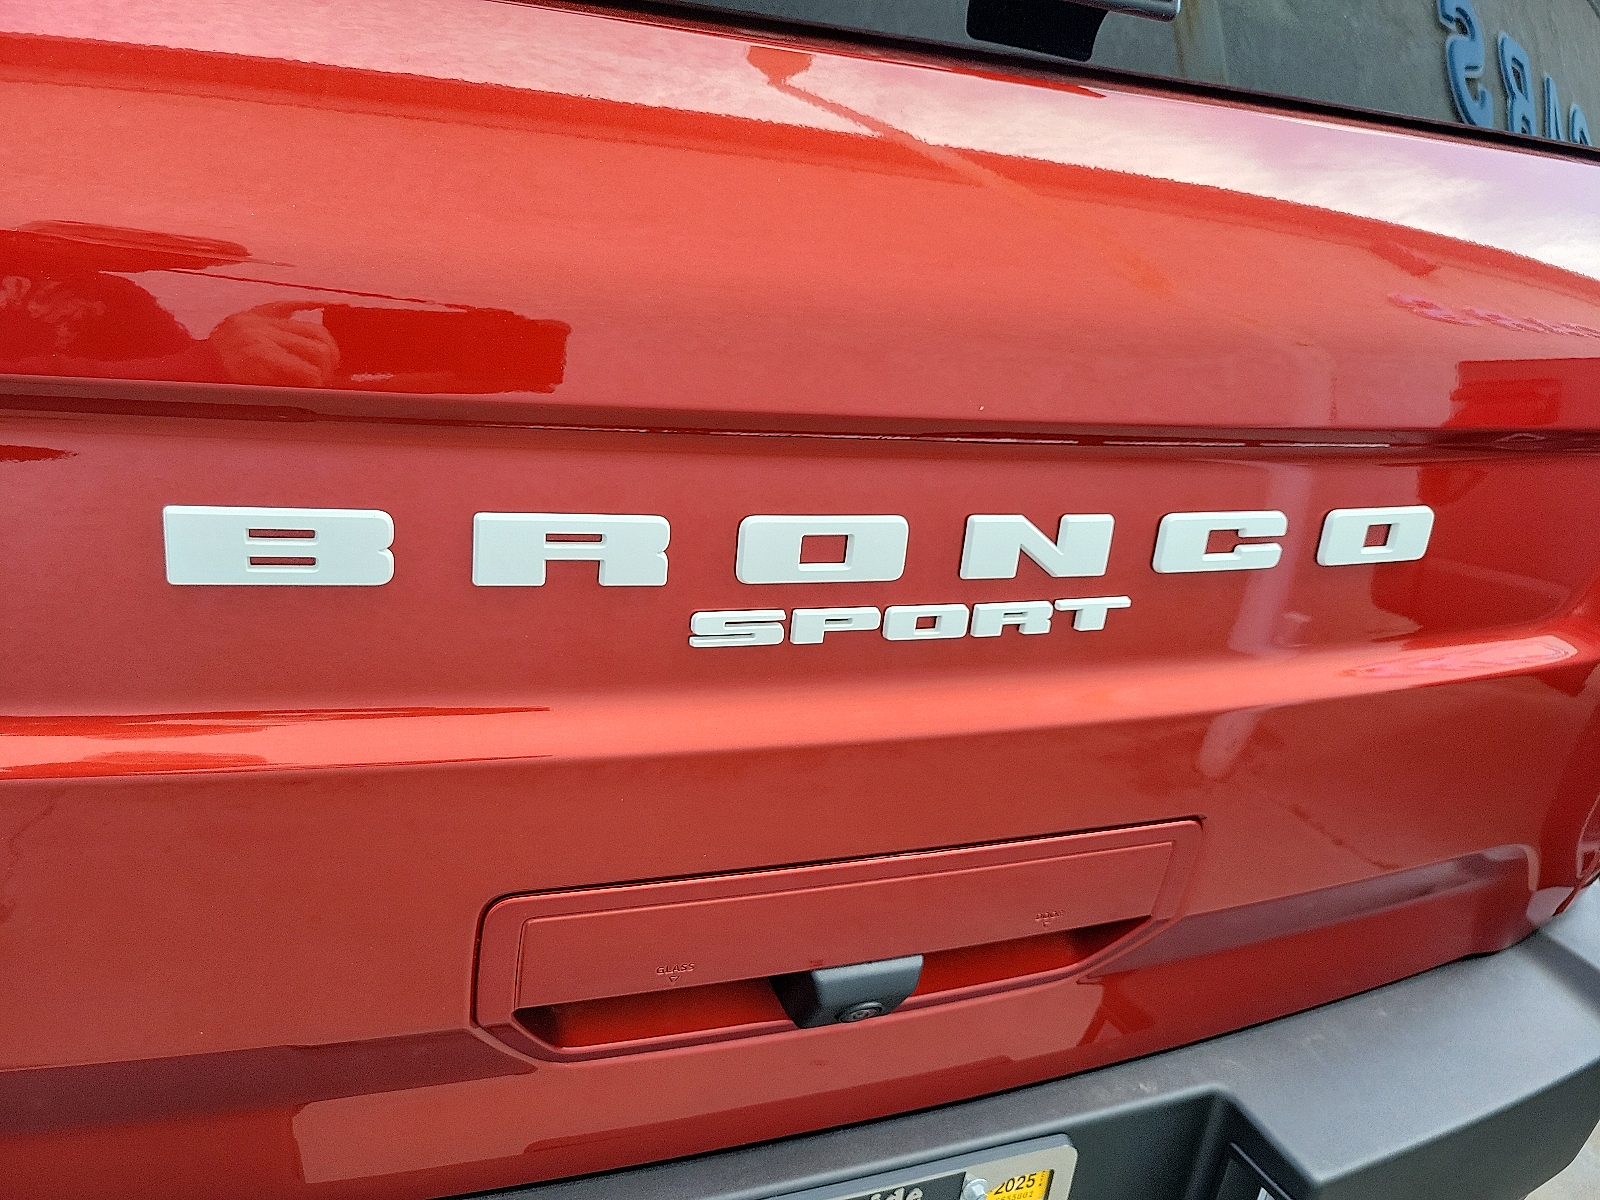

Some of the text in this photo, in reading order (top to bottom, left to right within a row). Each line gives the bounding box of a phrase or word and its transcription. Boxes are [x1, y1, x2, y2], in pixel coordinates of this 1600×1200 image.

[163, 504, 1436, 587] BRONCO
[689, 595, 1132, 648] SPORT
[656, 962, 695, 975] GLASS
[994, 1172, 1036, 1195] 2025
